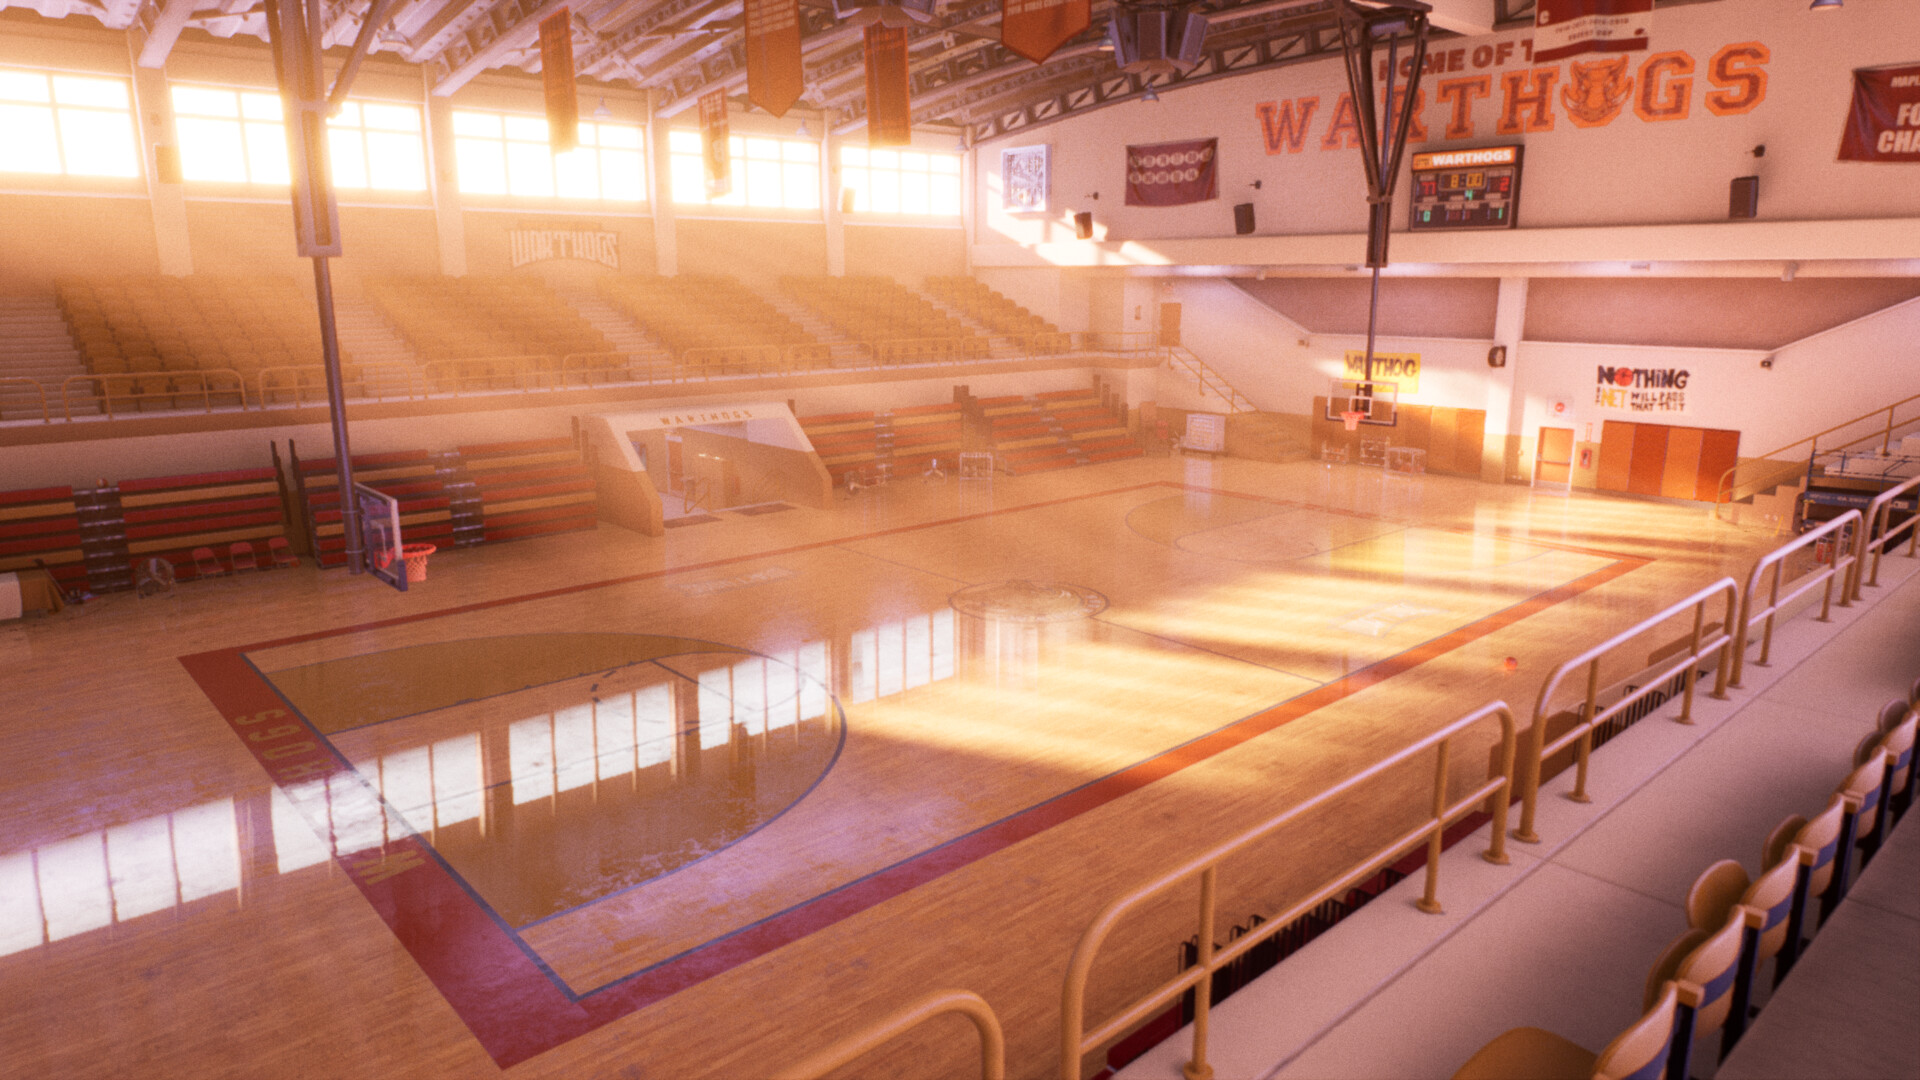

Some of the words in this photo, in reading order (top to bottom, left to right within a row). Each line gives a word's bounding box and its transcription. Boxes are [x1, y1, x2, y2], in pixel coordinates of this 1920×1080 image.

[1473, 41, 1514, 68] OF
[1432, 149, 1512, 166] WARTHOGS
[1499, 177, 1509, 192] 2
[510, 230, 619, 269] WARTHOGS
[1346, 354, 1416, 377] WATHOG
[1601, 388, 1627, 408] NET
[1631, 392, 1657, 401] WILL
[1630, 402, 1654, 411] THAT
[661, 410, 752, 425] WARTHOGS
